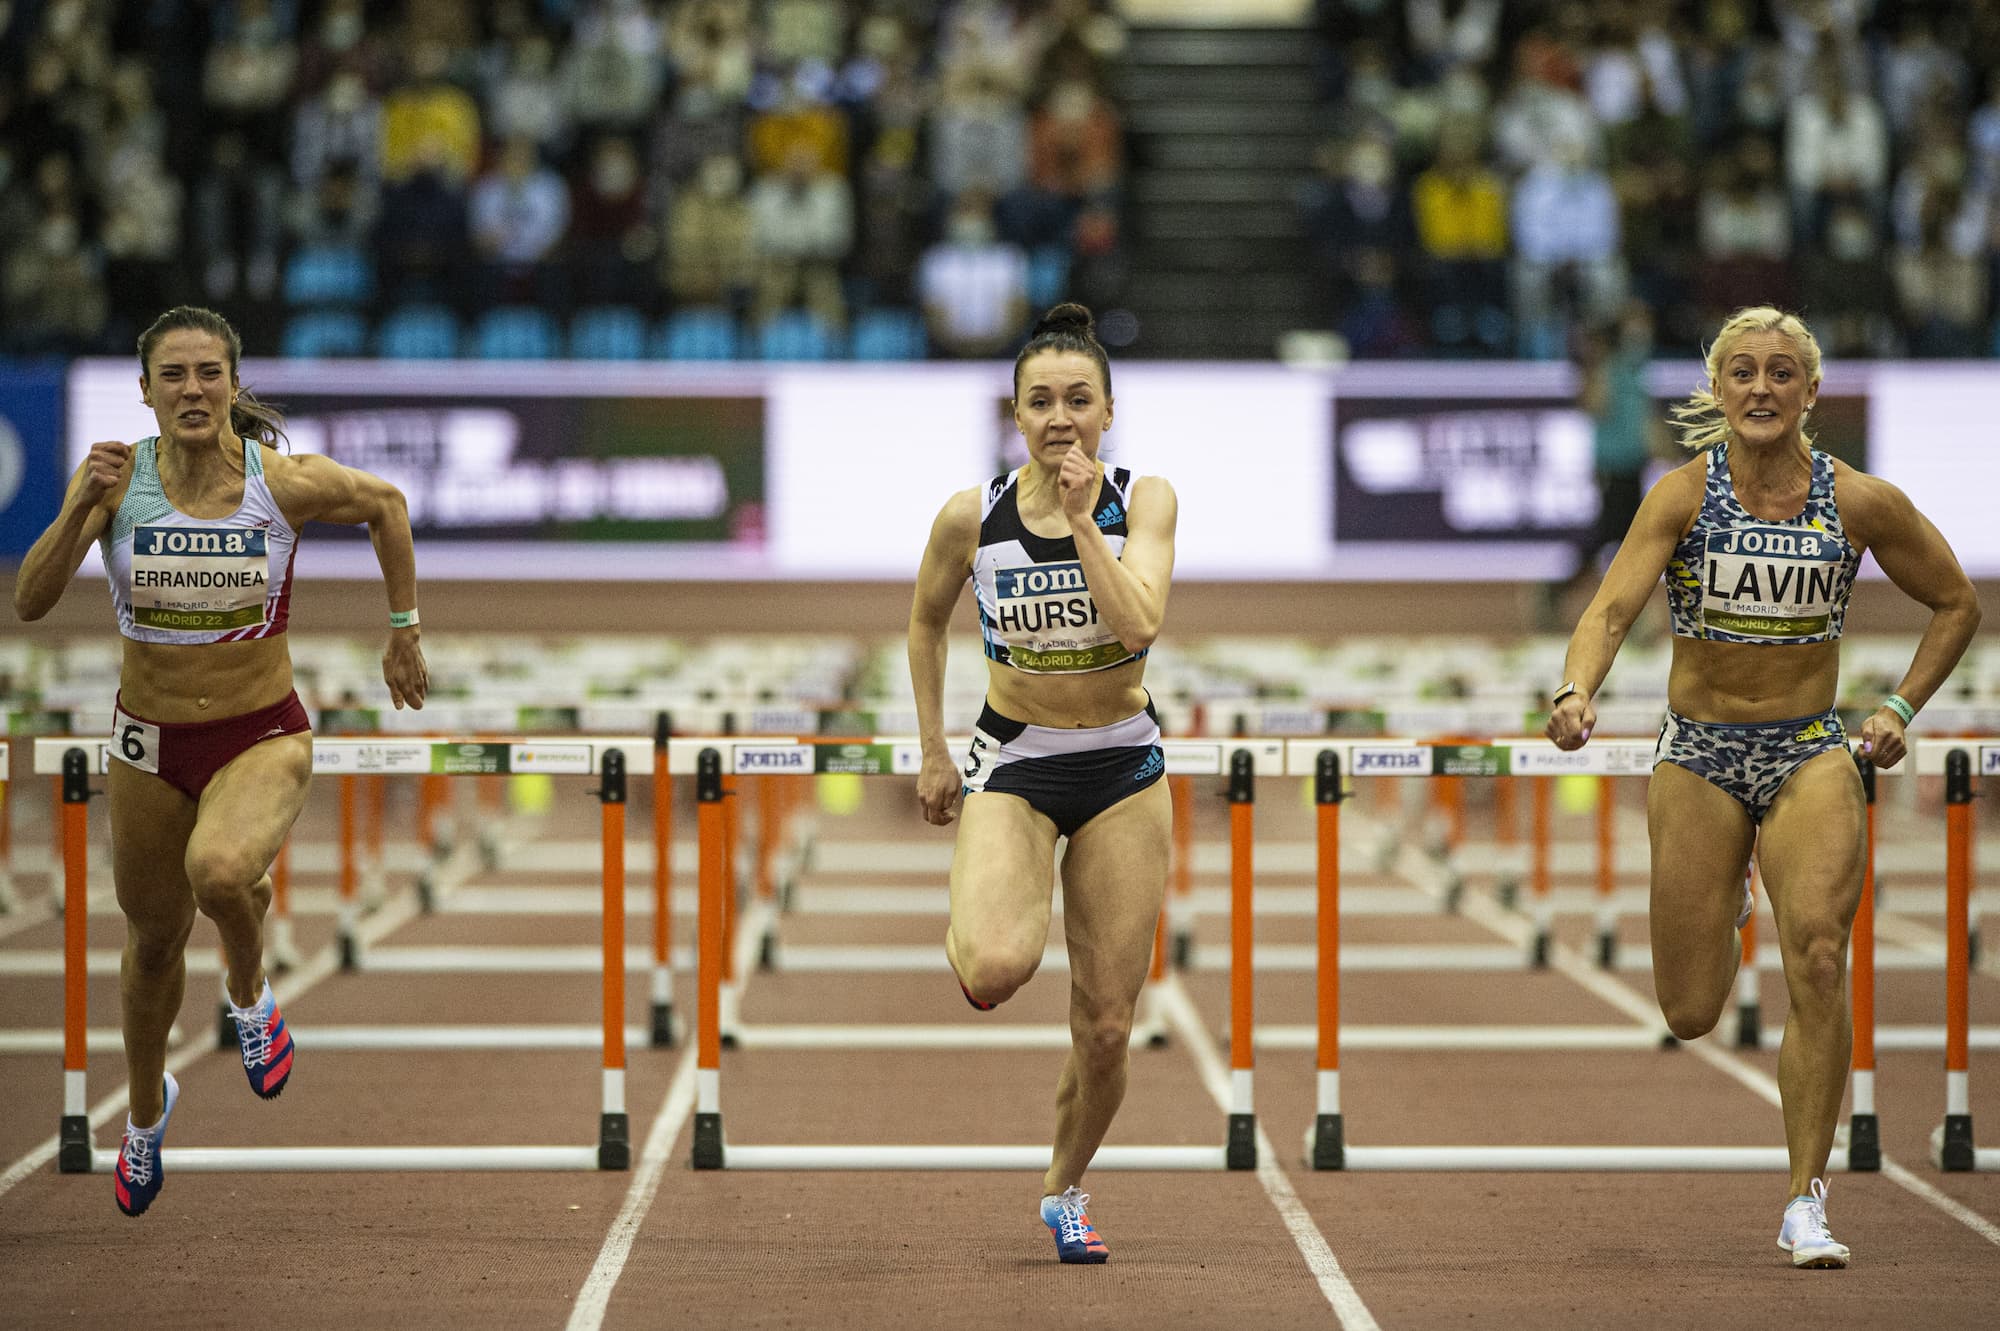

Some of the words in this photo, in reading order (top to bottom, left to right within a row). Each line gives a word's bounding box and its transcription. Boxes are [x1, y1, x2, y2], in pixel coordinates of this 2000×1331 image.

[135, 570, 265, 588] ERRANDONEA
[1011, 567, 1086, 597] Jom
[1707, 559, 1835, 605] LAVIN
[167, 601, 209, 610] MADRID
[1736, 603, 1779, 615] MADRID
[150, 611, 202, 626] MADRID
[205, 615, 223, 625] 22
[1773, 620, 1791, 632] 22
[1037, 639, 1078, 650] MADRID
[1022, 655, 1073, 668] MADRID
[1076, 653, 1095, 665] 22
[121, 724, 146, 761] 6
[964, 735, 987, 778] 5
[1134, 759, 1164, 781] adida
